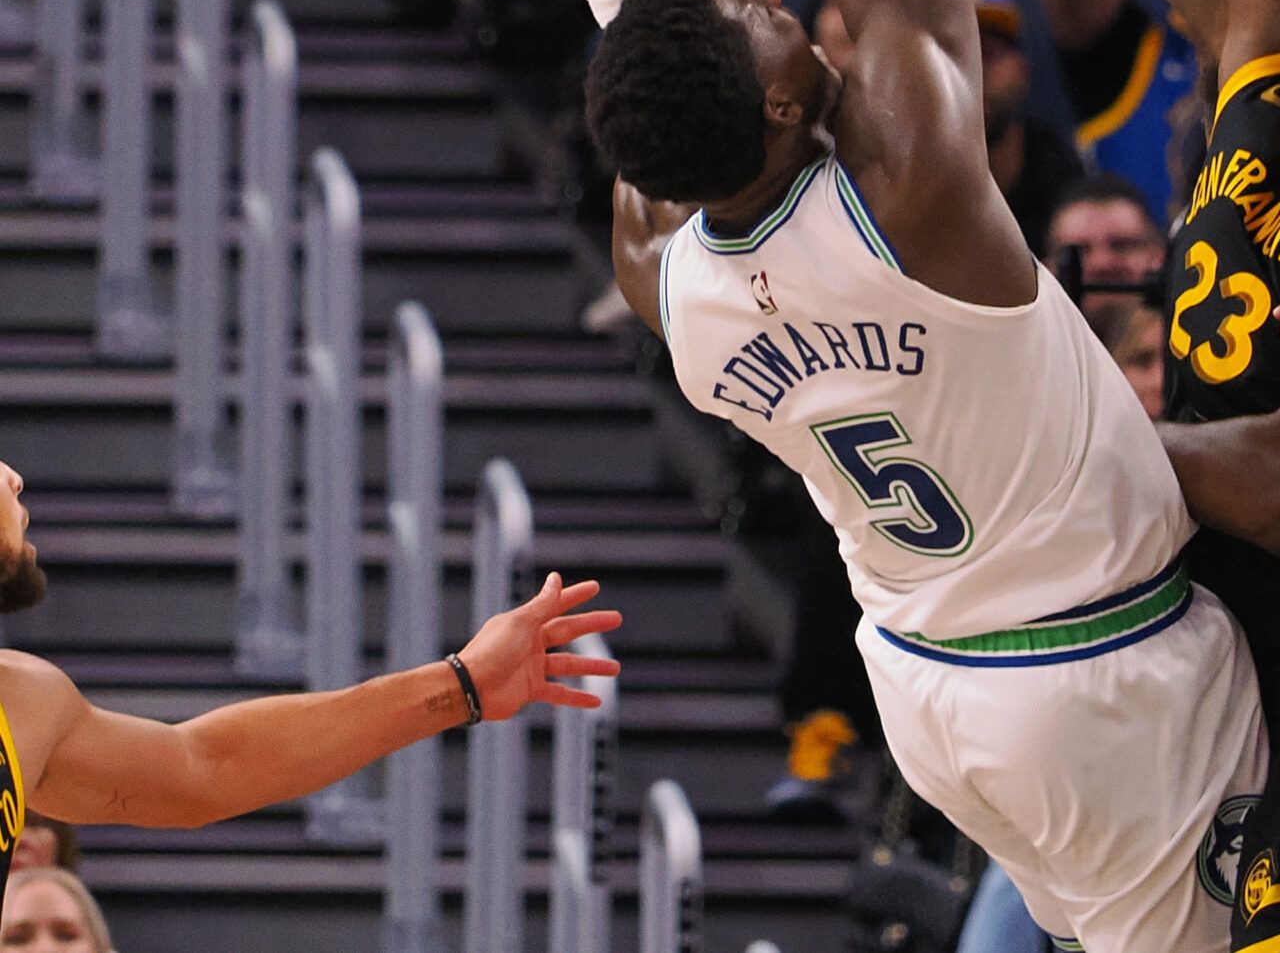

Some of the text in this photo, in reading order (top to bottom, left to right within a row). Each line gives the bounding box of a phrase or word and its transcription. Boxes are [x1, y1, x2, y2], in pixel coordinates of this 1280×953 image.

[713, 322, 927, 422] EDWARDS
[1169, 241, 1272, 385] 23
[808, 411, 975, 558] 5
